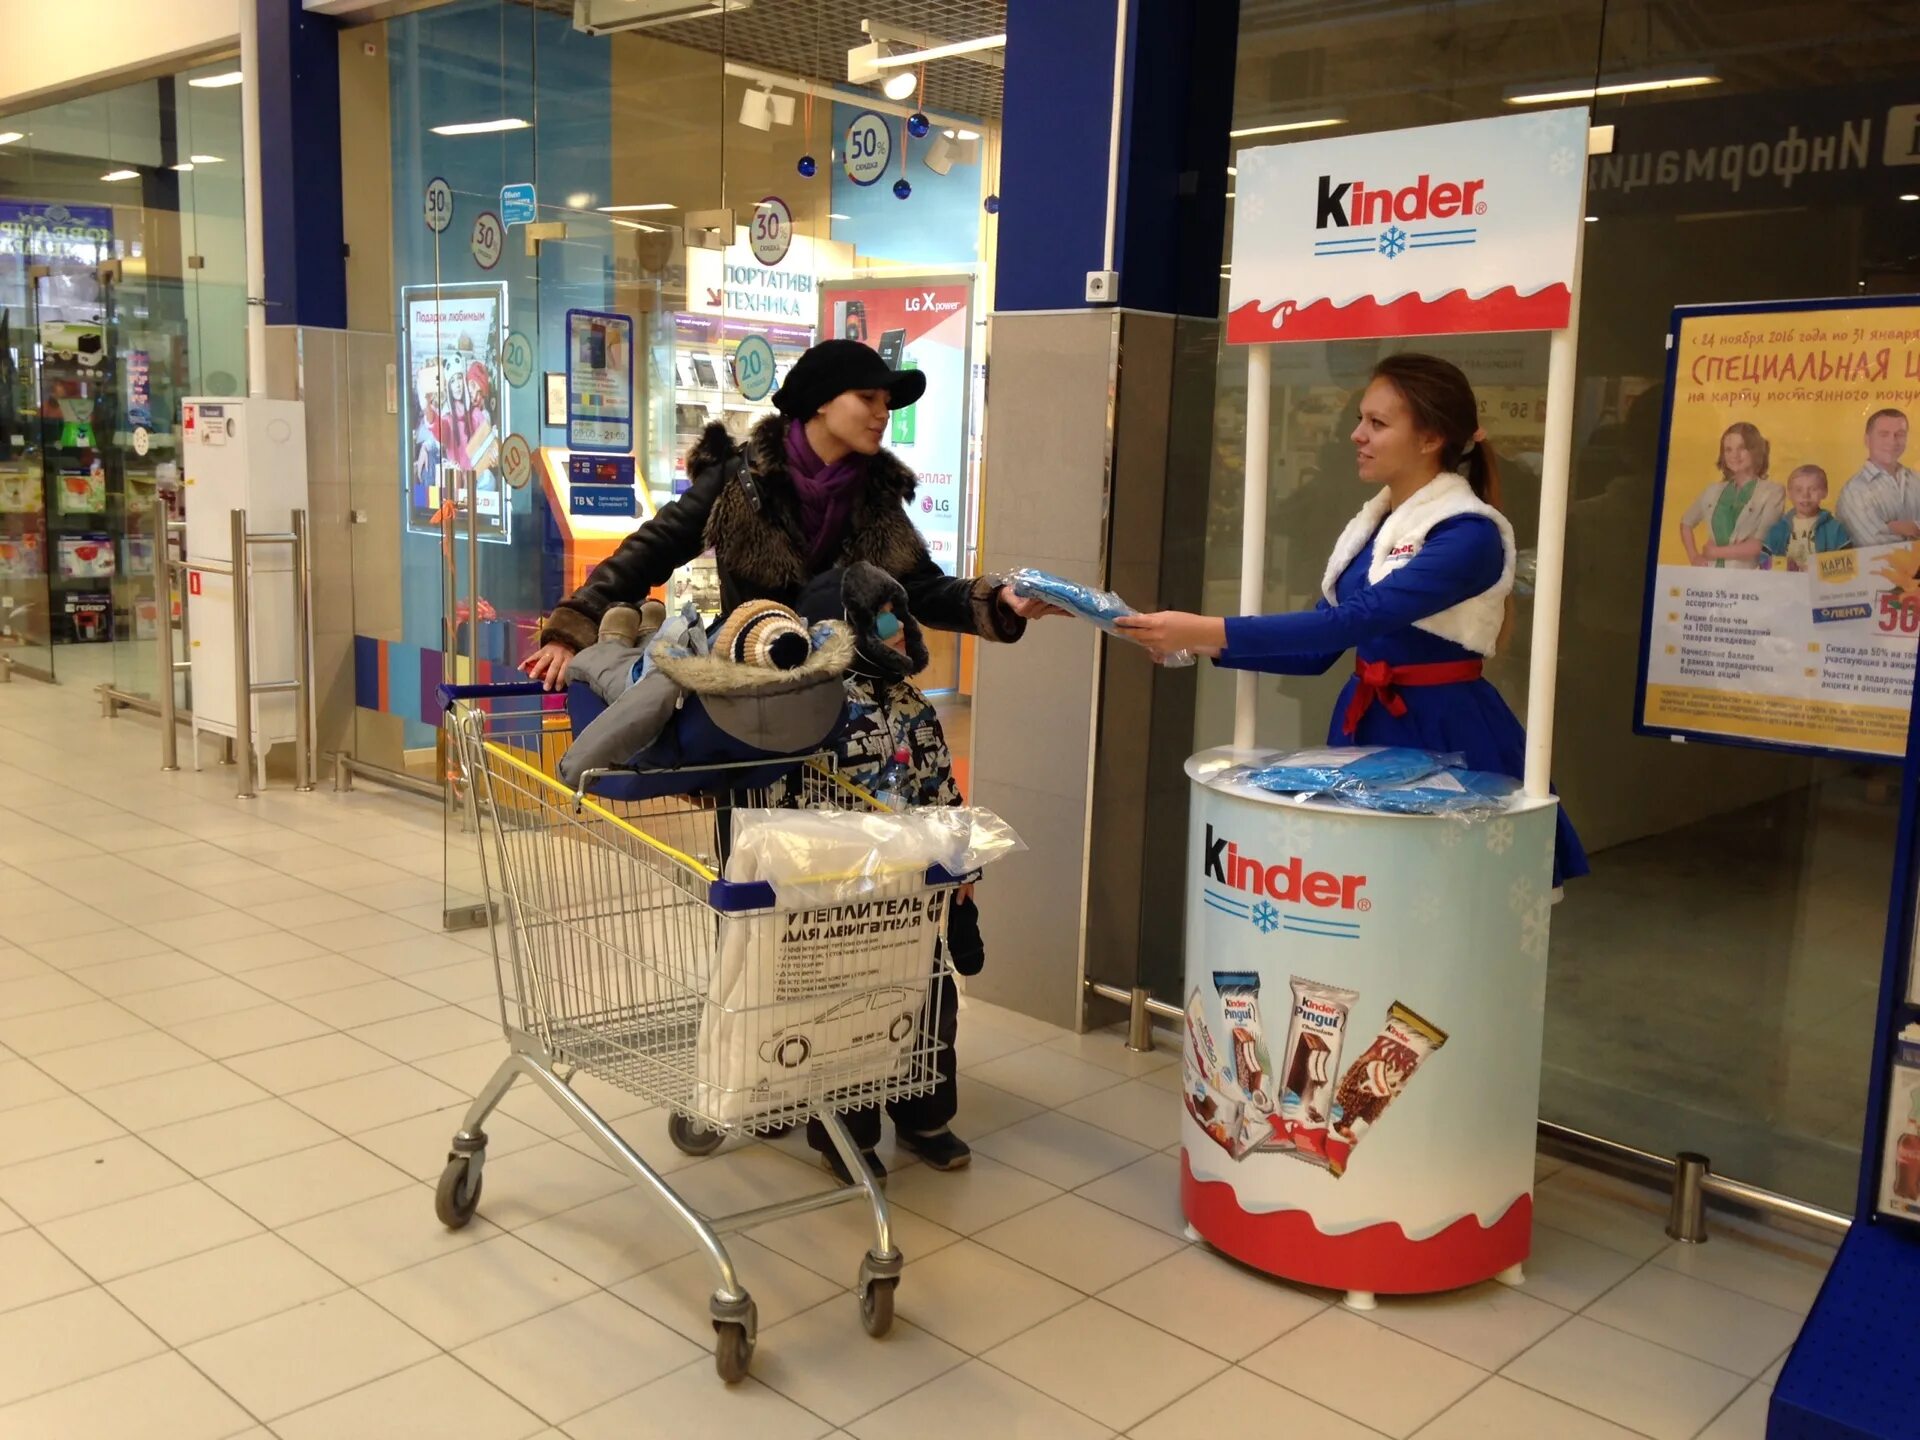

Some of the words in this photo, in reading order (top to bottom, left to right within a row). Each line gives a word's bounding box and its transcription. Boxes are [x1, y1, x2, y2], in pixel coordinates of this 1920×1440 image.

[1316, 175, 1484, 229] Kinder
[724, 289, 801, 316] ТЕХНИКА
[905, 298, 920, 312] LG
[1701, 333, 1715, 348] 24
[1720, 330, 1764, 348] ноября
[1768, 329, 1794, 344] 2016
[1800, 328, 1827, 343] года
[1832, 331, 1848, 341] по
[1852, 328, 1864, 344] 31
[1692, 348, 1891, 386] СПЕЦИАЛЬНАЯ
[1688, 391, 1705, 403] на
[1711, 388, 1760, 407] карту
[1767, 387, 1869, 402] постоянного
[935, 499, 949, 511] LG
[1822, 557, 1853, 571] КАРТА
[1716, 590, 1727, 599] 5%
[1831, 606, 1866, 618] ЛЕНТА
[1826, 643, 1855, 654] Скидка
[1871, 647, 1888, 657] 50%
[1205, 823, 1367, 910] Kinder
[1225, 999, 1246, 1007] Kinder
[1302, 996, 1337, 1014] Kinder
